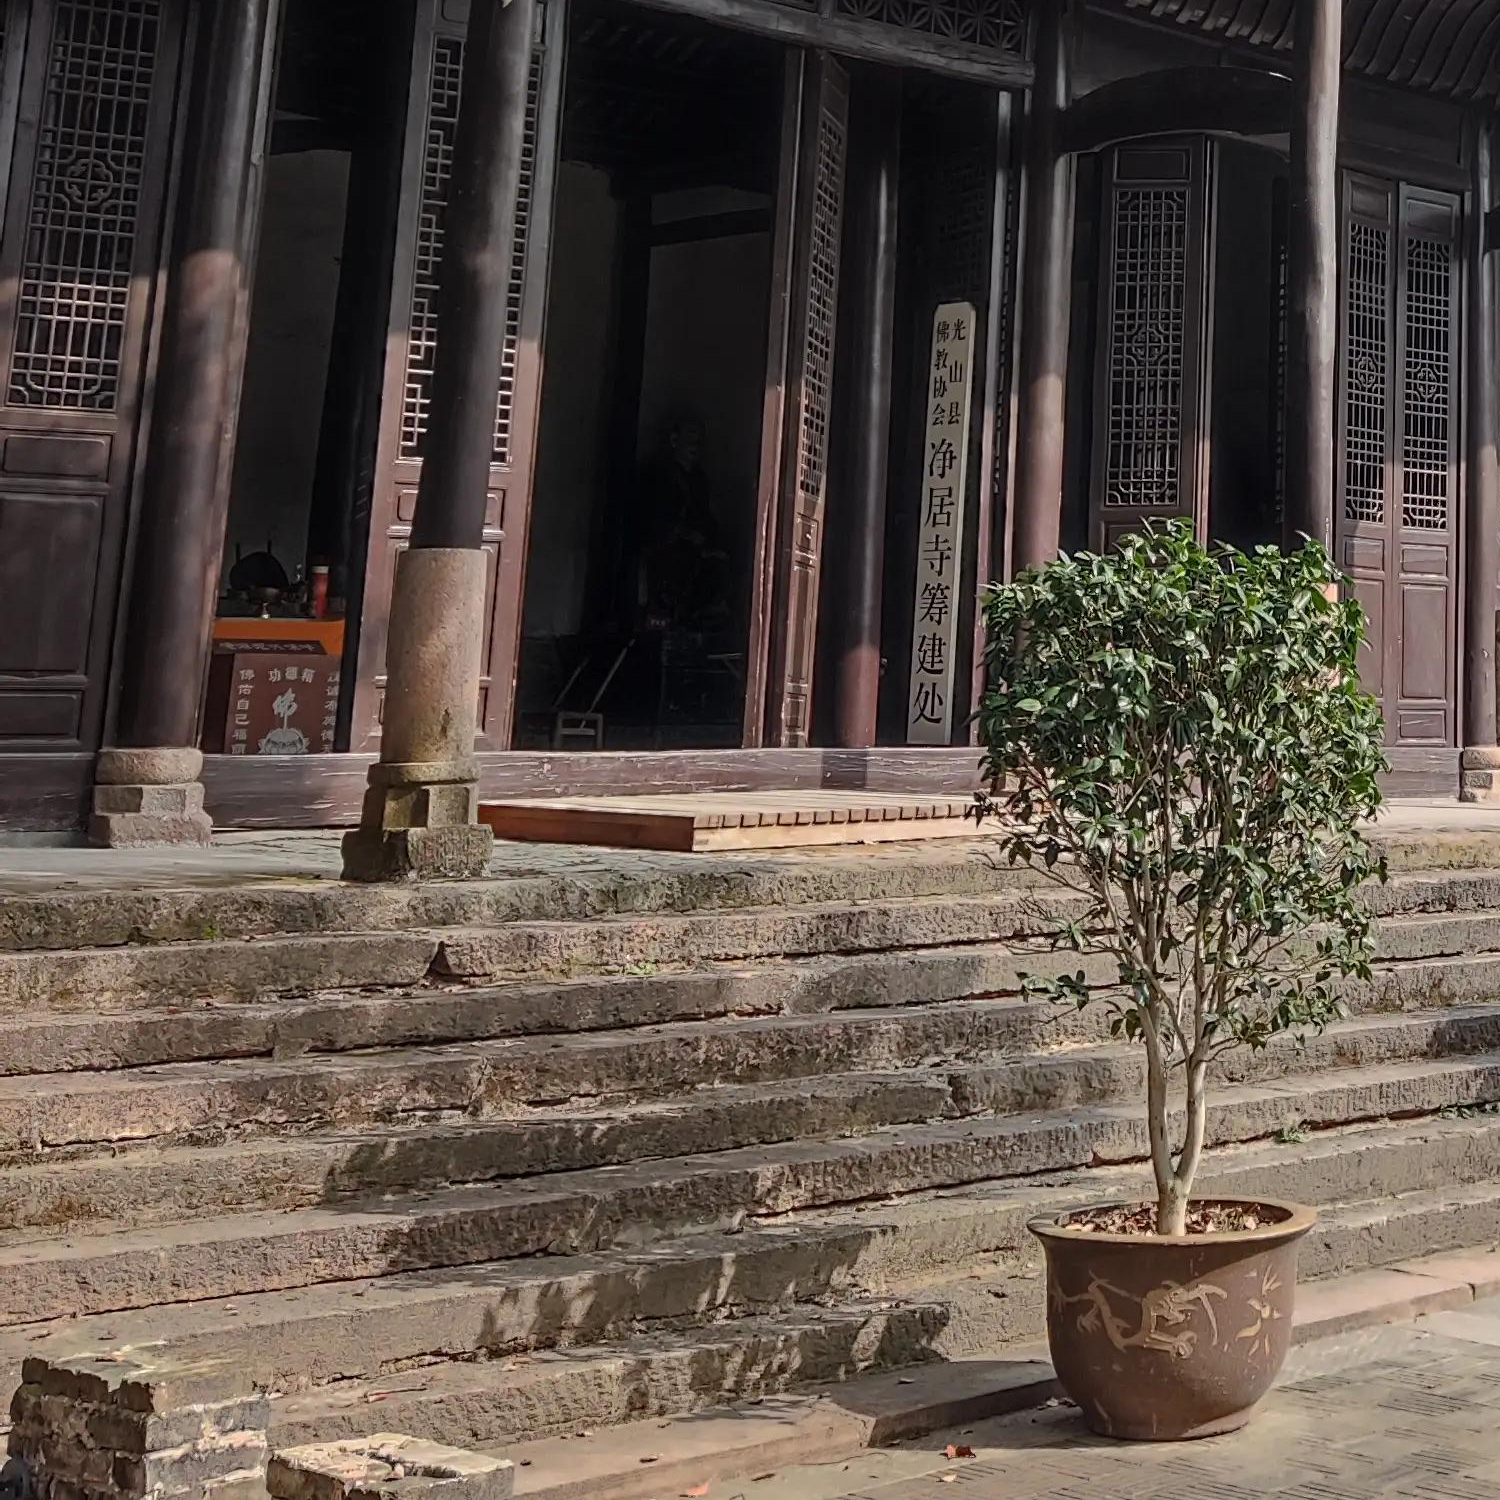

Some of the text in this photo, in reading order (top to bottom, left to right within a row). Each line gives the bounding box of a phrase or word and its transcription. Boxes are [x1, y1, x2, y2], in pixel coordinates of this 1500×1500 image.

[948, 318, 966, 425] 光山县
[912, 437, 958, 725] 净居寺筹建处
